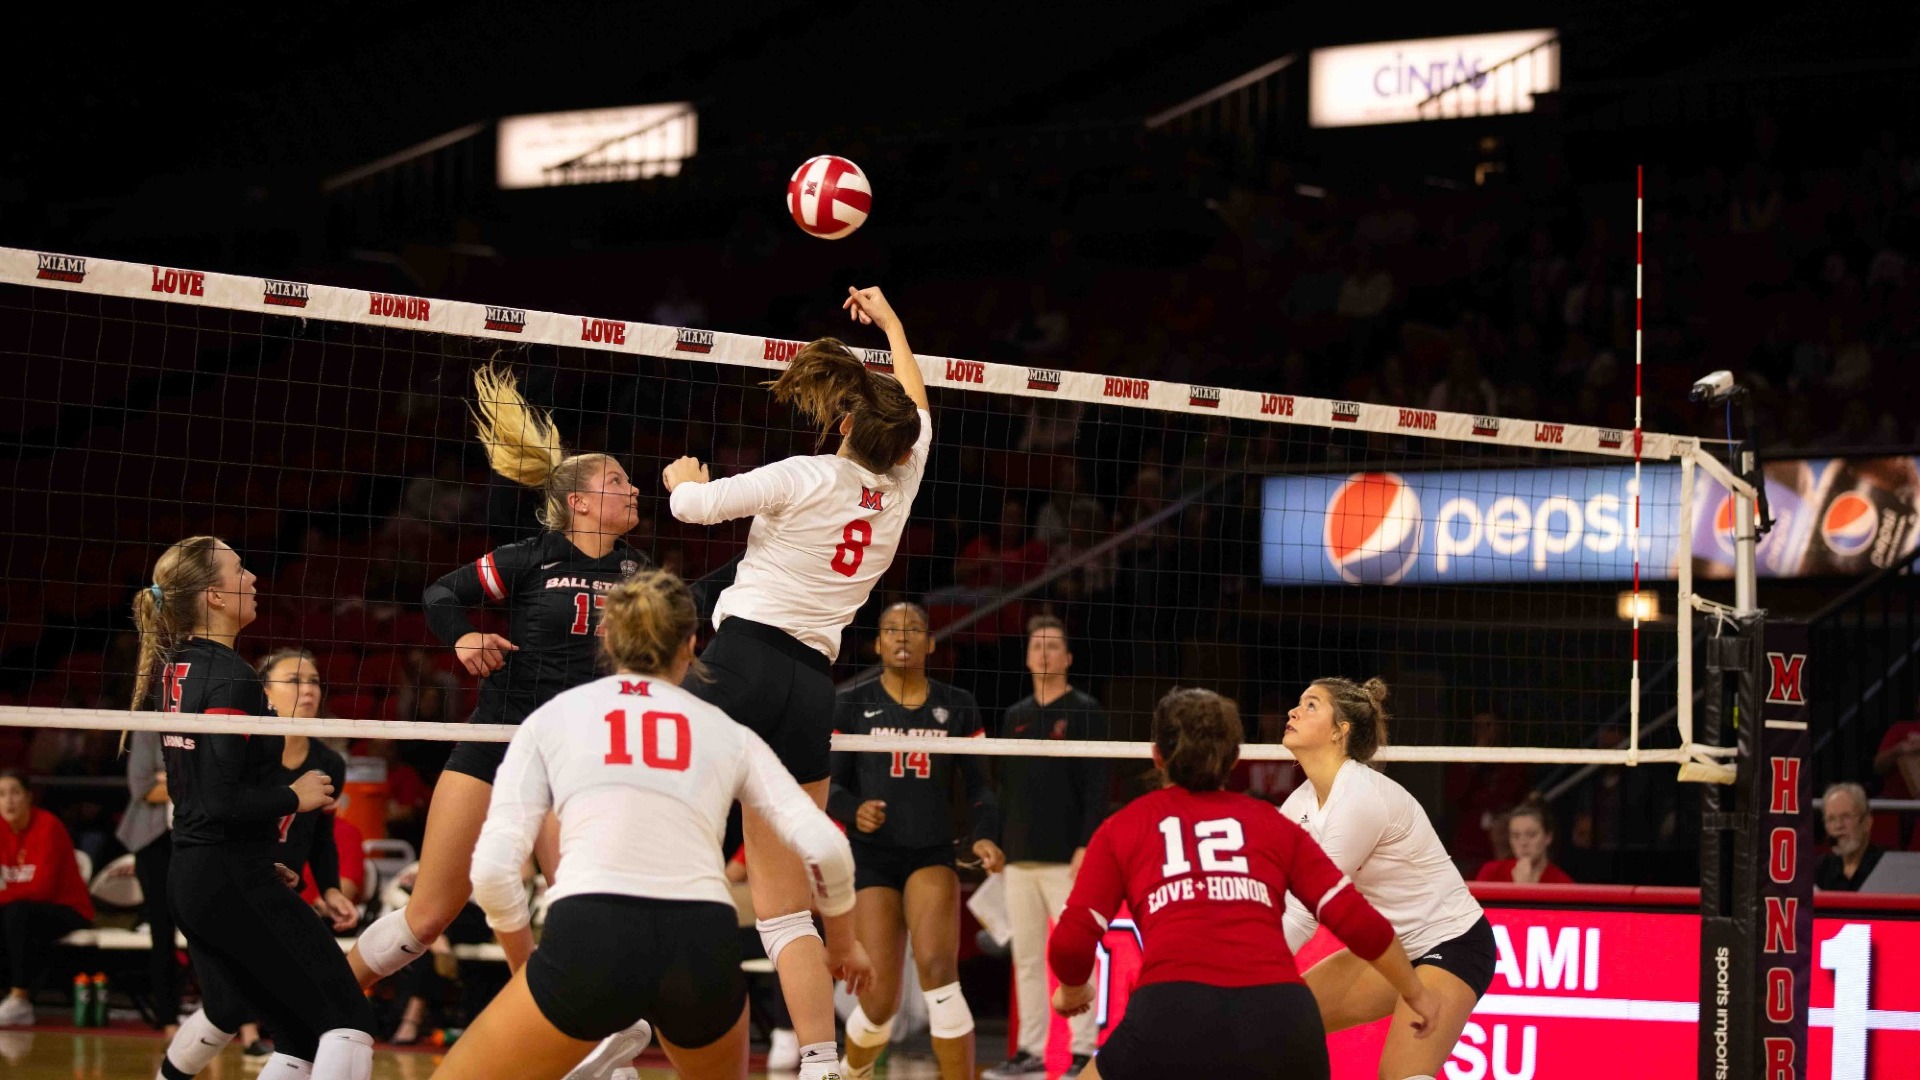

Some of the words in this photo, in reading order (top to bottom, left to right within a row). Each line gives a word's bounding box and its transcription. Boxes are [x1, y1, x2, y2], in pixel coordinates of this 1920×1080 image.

[39, 254, 85, 274] MIAMI
[151, 266, 205, 297] LOVE
[265, 281, 308, 299] MIAMI
[369, 292, 431, 322] HONOR
[486, 308, 526, 325] MIAMI
[581, 318, 626, 346] LOVE
[678, 329, 714, 346] MIAMI
[763, 338, 804, 362] HON
[864, 350, 893, 367] MIAM
[945, 358, 985, 384] LOVE
[1028, 368, 1061, 384] MIAMI
[1103, 376, 1150, 401] HONOR
[1190, 386, 1221, 401] MIAMI
[1260, 393, 1295, 417] LOVE
[1332, 402, 1360, 416] MIAMI
[1397, 408, 1438, 431] HONOR
[1473, 416, 1500, 430] MIAMI
[1534, 422, 1565, 444] LOVE
[1600, 429, 1624, 443] MIAMI
[858, 486, 884, 511] M
[1435, 478, 1641, 574] pepsi
[830, 518, 873, 578] 8
[545, 577, 590, 589] BALL
[592, 580, 625, 592] STA
[618, 680, 653, 697] M
[1766, 653, 1807, 704] M
[604, 709, 692, 772] 10
[890, 751, 931, 778] 14
[1158, 816, 1249, 878] 12
[1764, 757, 1800, 1080] HONOR
[1492, 924, 1601, 991] AMI
[1715, 946, 1730, 1006] sports
[1820, 923, 1871, 1080] 1
[1443, 1021, 1538, 1080] SU
[1714, 1009, 1729, 1080] imports
